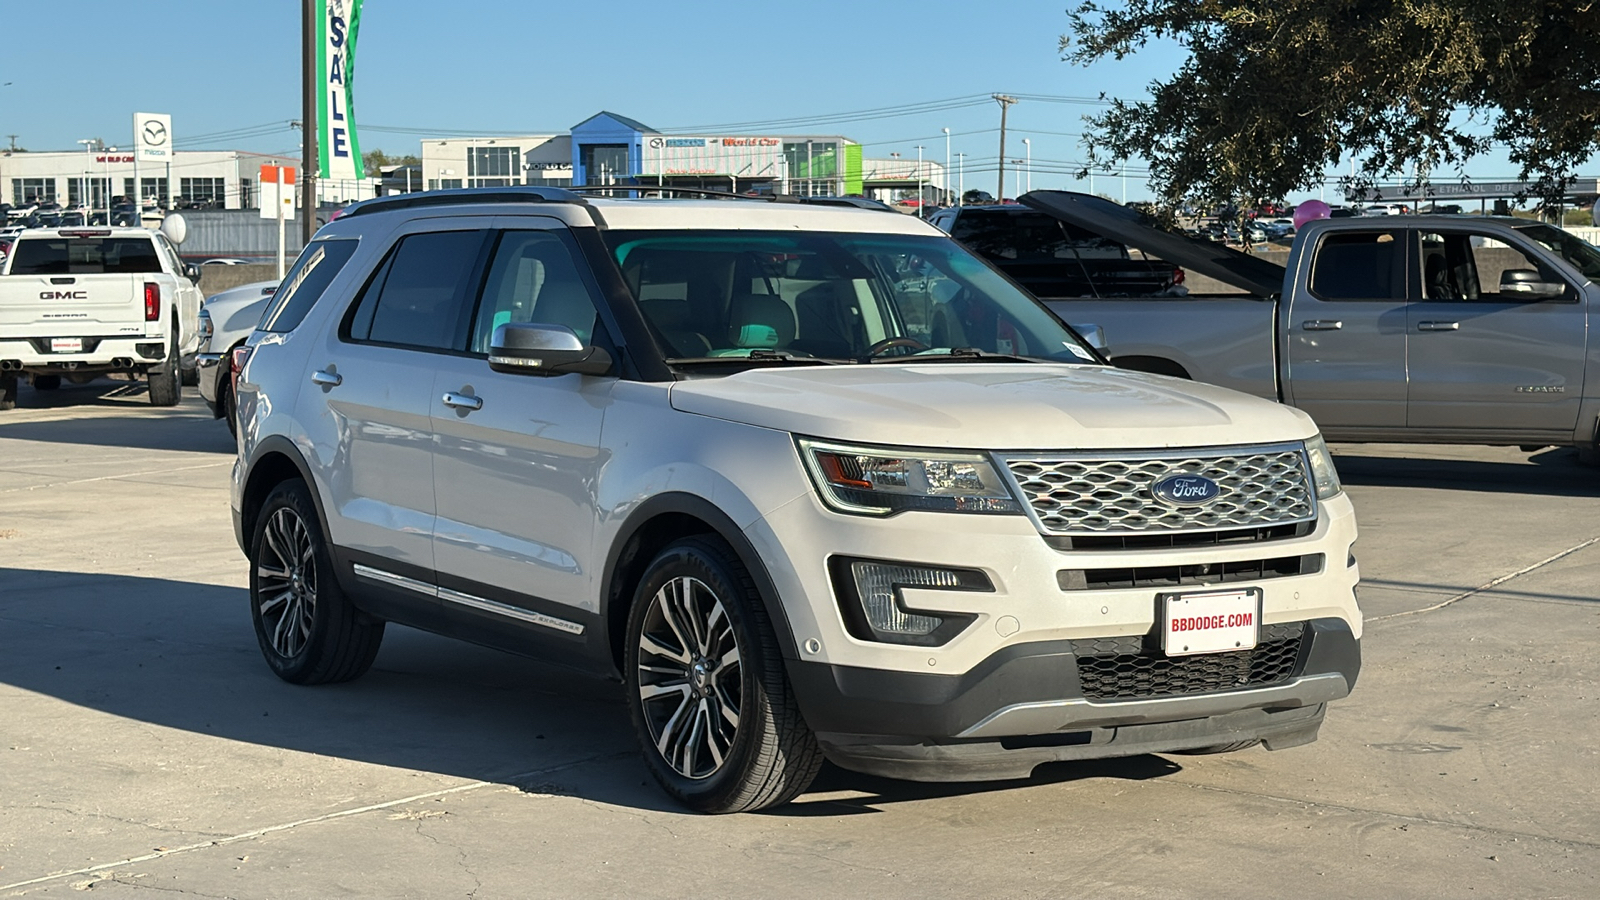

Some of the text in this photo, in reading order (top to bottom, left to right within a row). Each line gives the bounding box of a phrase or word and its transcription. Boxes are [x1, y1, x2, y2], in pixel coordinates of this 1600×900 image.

[329, 16, 349, 158] SALE
[1495, 183, 1513, 192] DEF
[40, 291, 88, 300] GMC
[1172, 478, 1209, 498] Ford
[538, 616, 581, 631] EXPLORER
[1171, 612, 1253, 632] BBDODGE.COM
